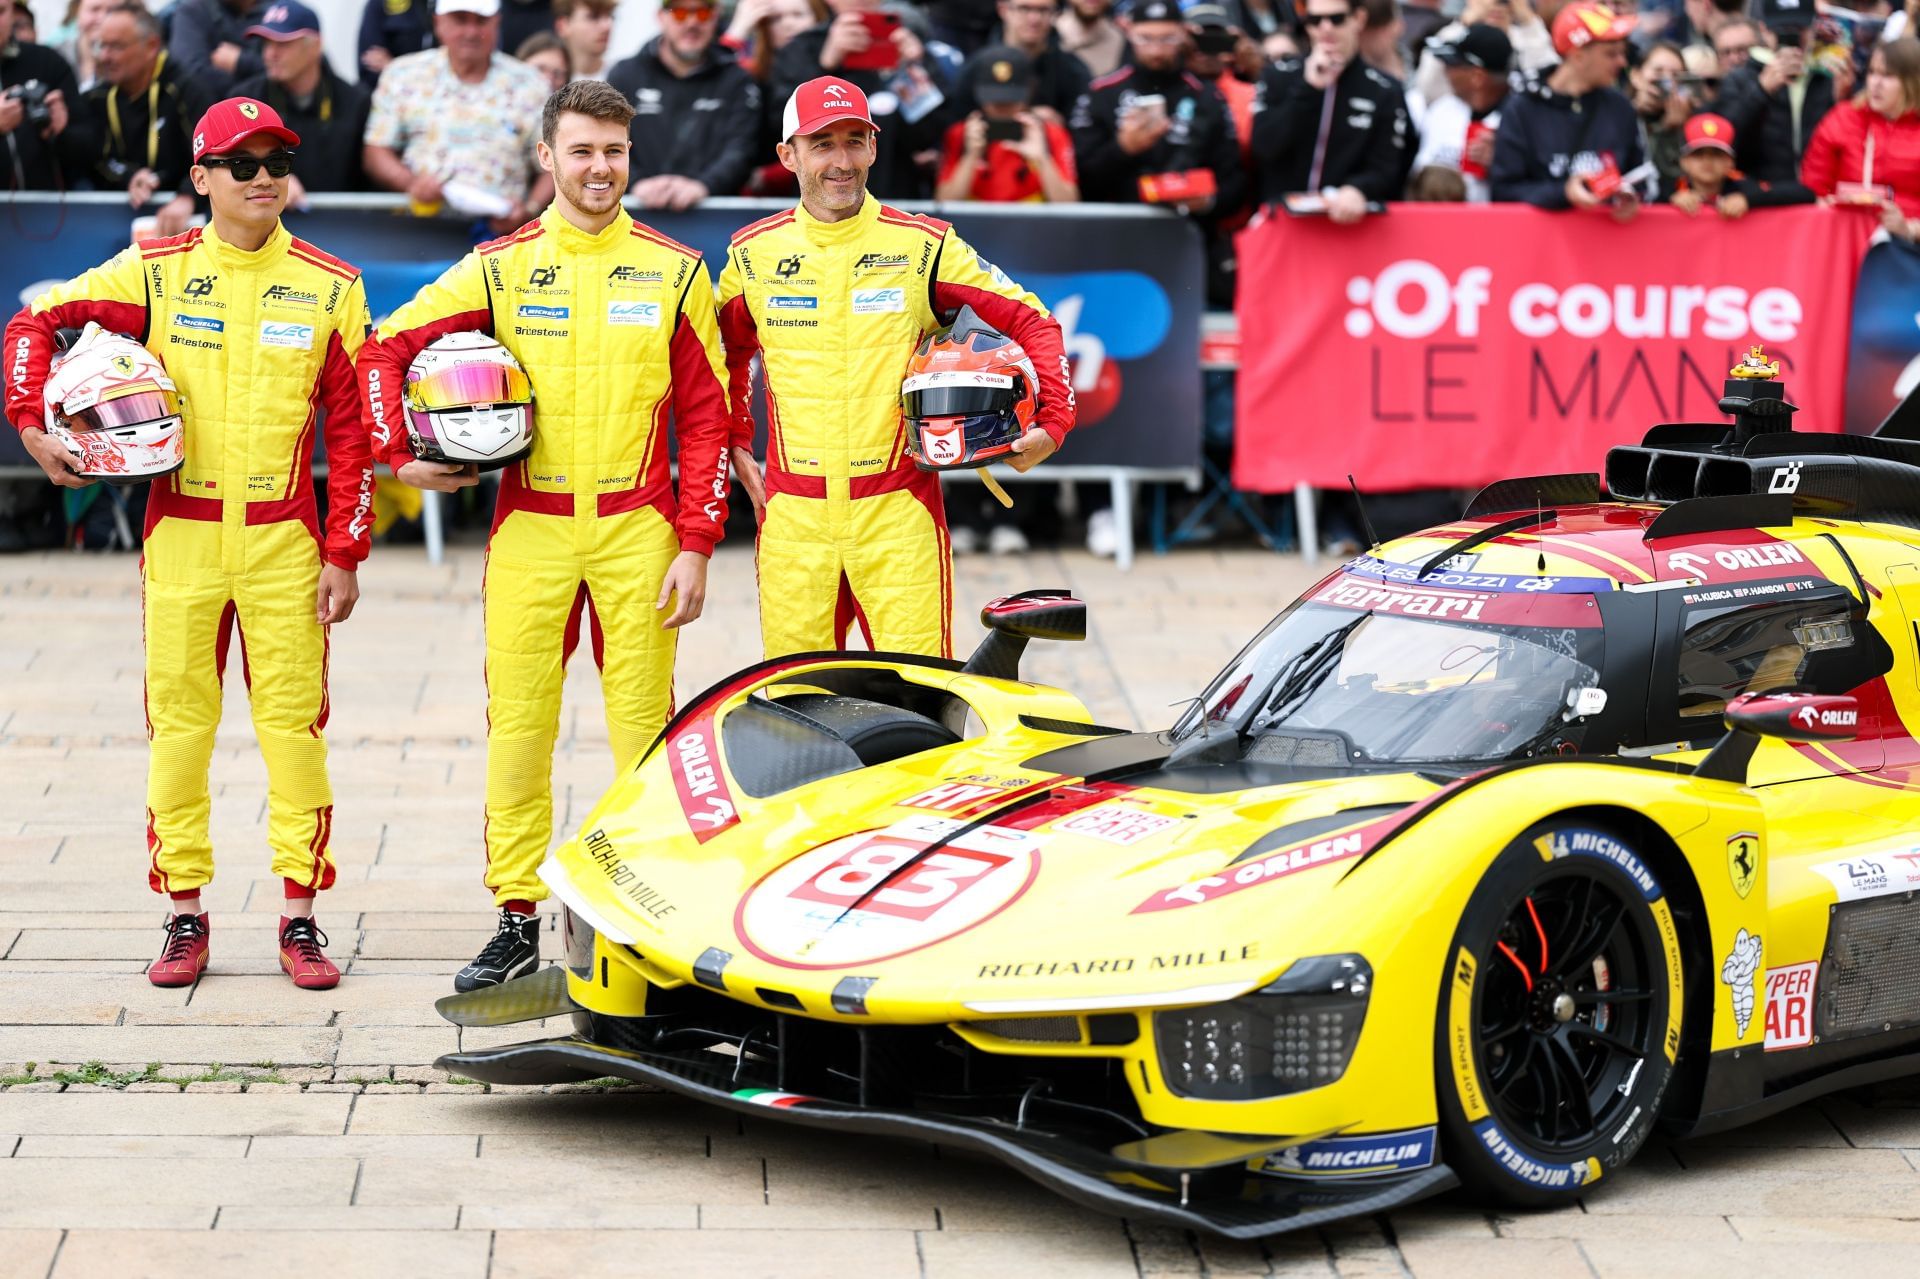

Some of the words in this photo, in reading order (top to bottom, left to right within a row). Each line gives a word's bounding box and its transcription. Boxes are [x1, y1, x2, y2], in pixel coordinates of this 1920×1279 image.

[823, 100, 853, 108] ORLEN
[673, 258, 690, 289] Sabelt
[739, 247, 756, 281] Sabelt
[917, 240, 934, 278] Sabelt
[151, 263, 164, 298] Sabelt
[489, 258, 505, 292] Sabelt
[170, 295, 203, 306] CHARLES
[204, 301, 227, 309] POZZI
[325, 280, 343, 315] Sabelt
[526, 307, 564, 316] MICHELIN
[610, 304, 658, 316] WEC
[855, 290, 901, 304] WEC
[1509, 283, 1803, 341] course
[183, 318, 221, 329] MICHELIN
[263, 324, 312, 339] WEC
[515, 326, 568, 337] Britestone
[766, 317, 818, 327] Britestone
[170, 335, 223, 351] Britestone
[1059, 355, 1076, 403] OLEN
[1371, 343, 1478, 421] LE
[850, 458, 883, 467] KUBICA
[532, 474, 552, 482] Sabelt
[598, 476, 632, 485] HANSON
[1715, 543, 1804, 570] ORLEN
[1346, 556, 1416, 581] HARLES
[1424, 572, 1507, 588] POZZI
[1317, 578, 1489, 620] Ferrari
[1694, 590, 1733, 603] R.KUBICA
[1743, 584, 1786, 597] P.HANSON
[1795, 580, 1815, 592] Y.YE
[1821, 711, 1857, 725] ORLEN
[677, 733, 718, 797] ORLEN
[1063, 813, 1149, 842] CAR
[1081, 807, 1170, 829] HYPER
[584, 828, 636, 886] RICHARD
[626, 881, 678, 919] MILLE
[1235, 833, 1362, 884] ORLEN
[1571, 833, 1655, 891] MICHELIN
[814, 844, 996, 908] 83
[1864, 875, 1888, 885] MANS
[978, 957, 1136, 979] RICHARD
[1149, 942, 1260, 971] MILLE
[1660, 909, 1674, 943] PILOT
[1671, 946, 1681, 991] SPORT
[1459, 960, 1473, 986] M
[1765, 997, 1806, 1040] AR
[1456, 1025, 1468, 1070] SPORT
[1668, 1031, 1678, 1052] M
[1463, 1075, 1479, 1110] PILOT
[1307, 1142, 1423, 1167] MICHELIN
[1482, 1128, 1569, 1186] MICHELIN
